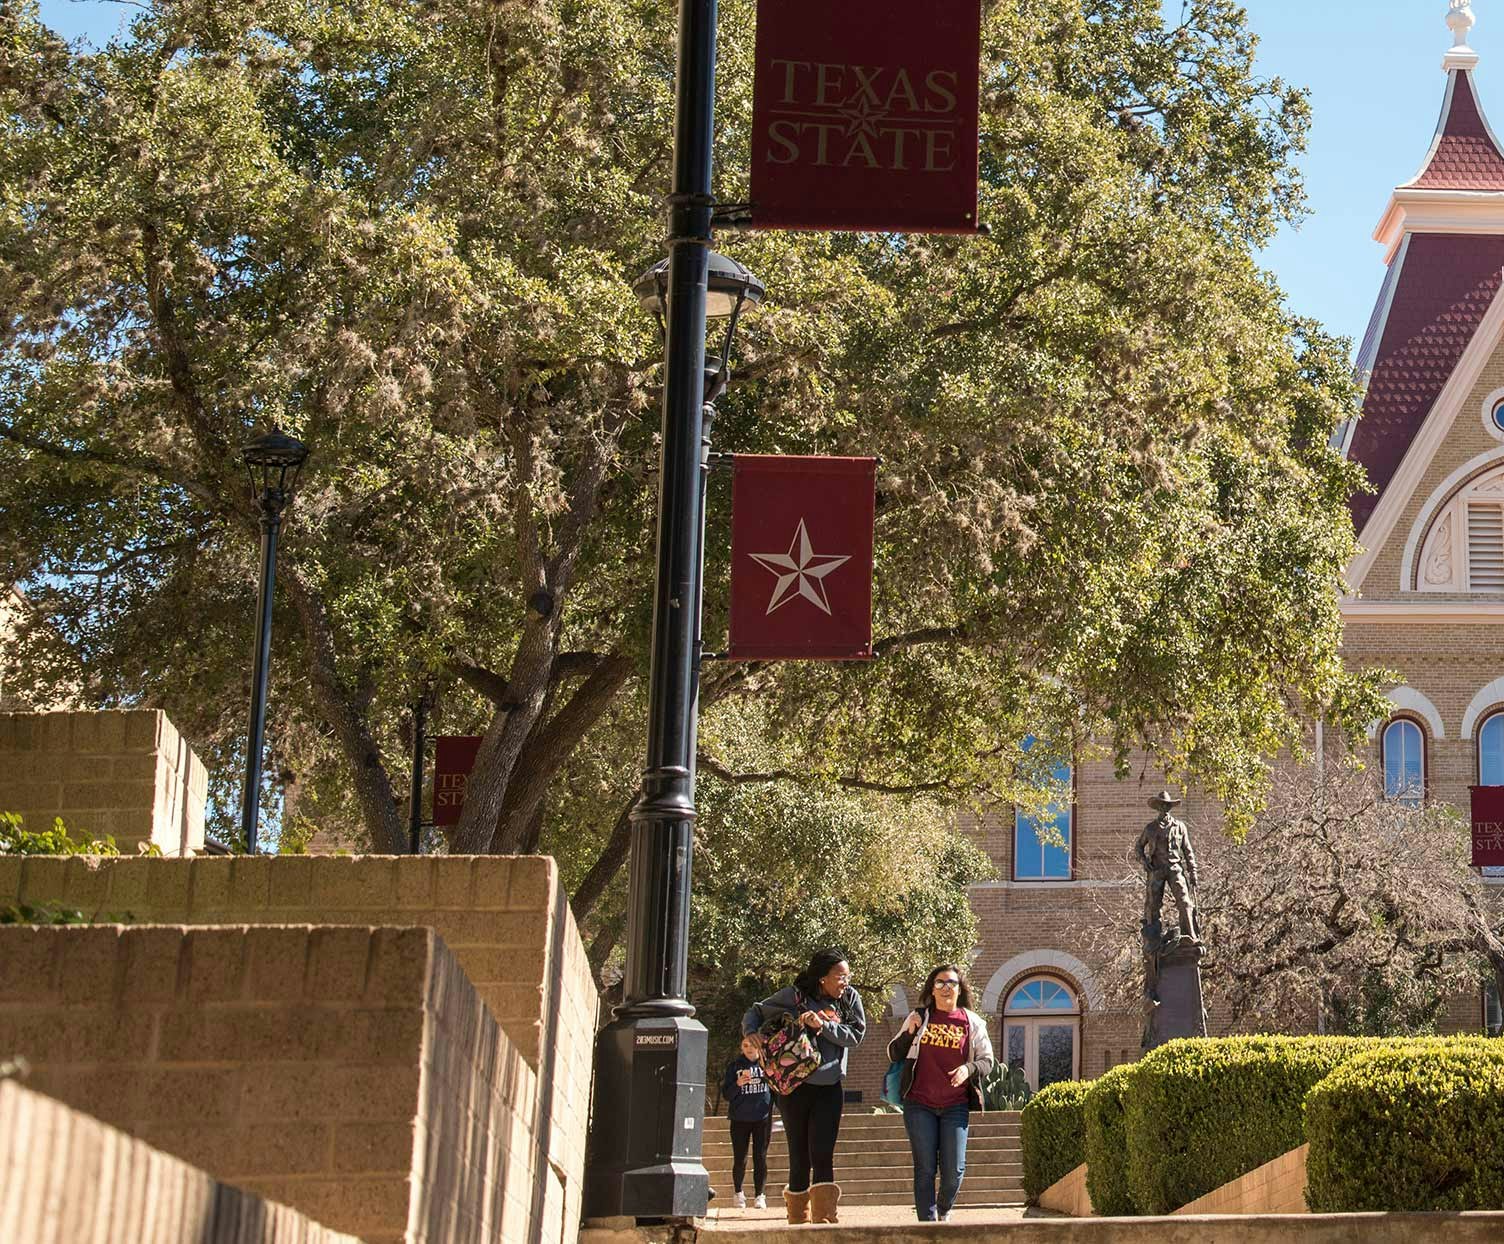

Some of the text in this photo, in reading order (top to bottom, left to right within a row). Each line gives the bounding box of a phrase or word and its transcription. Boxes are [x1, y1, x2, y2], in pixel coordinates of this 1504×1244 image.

[770, 58, 958, 113] TEXAS
[766, 119, 956, 172] STATE
[920, 1032, 961, 1048] STATE
